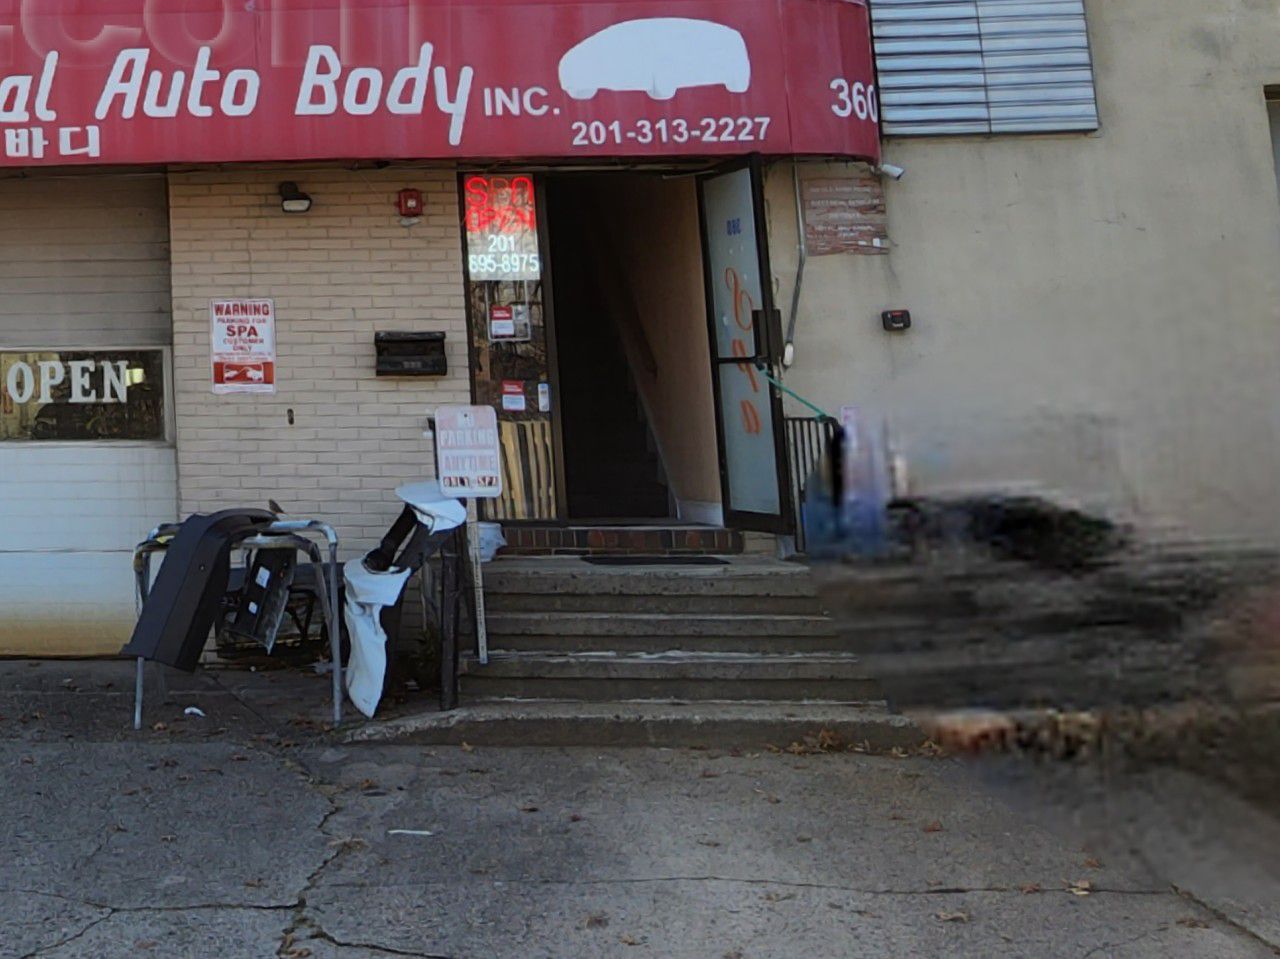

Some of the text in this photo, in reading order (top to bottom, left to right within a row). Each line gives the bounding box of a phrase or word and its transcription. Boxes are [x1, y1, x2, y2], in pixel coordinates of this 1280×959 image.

[95, 46, 260, 120] Auto
[295, 42, 473, 146] Body
[484, 86, 560, 117] INC.
[571, 117, 771, 145] 201-313-2227
[487, 234, 516, 252] 201
[468, 254, 540, 273] 695-8975
[215, 303, 270, 316] WARNING
[226, 325, 258, 337] SPA
[7, 360, 129, 404] OPEN
